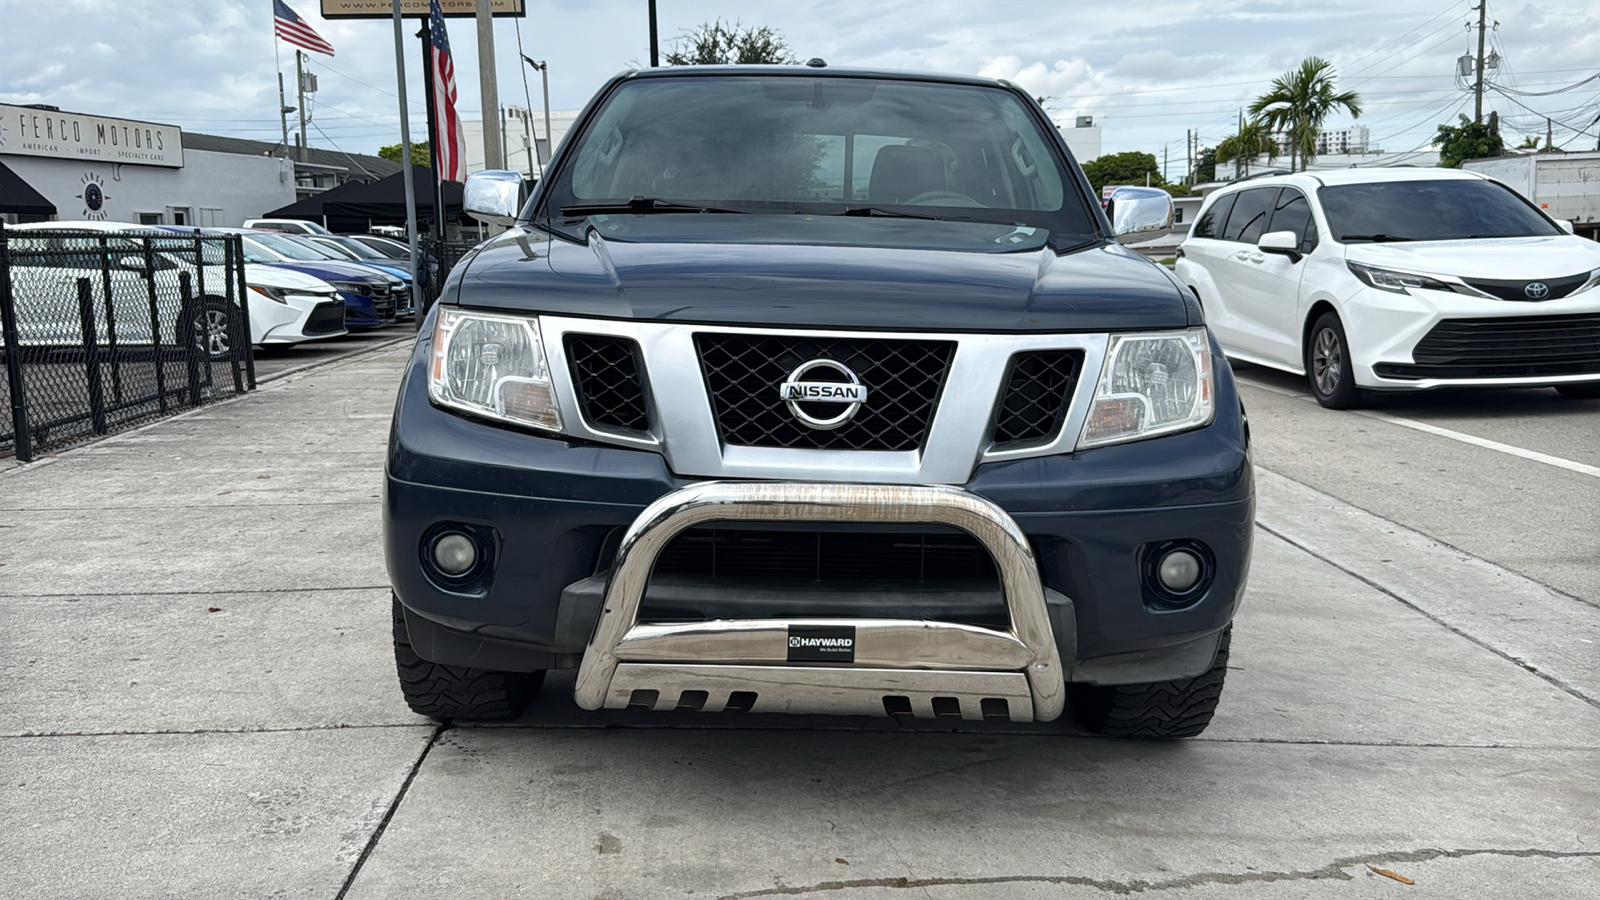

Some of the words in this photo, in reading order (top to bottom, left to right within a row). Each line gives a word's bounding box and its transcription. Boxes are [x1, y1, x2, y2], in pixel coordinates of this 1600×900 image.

[20, 114, 81, 142] FERCO
[97, 123, 164, 151] MOTORS
[22, 142, 59, 152] AMERICAN
[76, 147, 101, 156] IMPORT
[117, 151, 148, 160] SPECIALTY
[789, 385, 859, 398] NISSAN
[801, 638, 852, 646] HAYWARD
